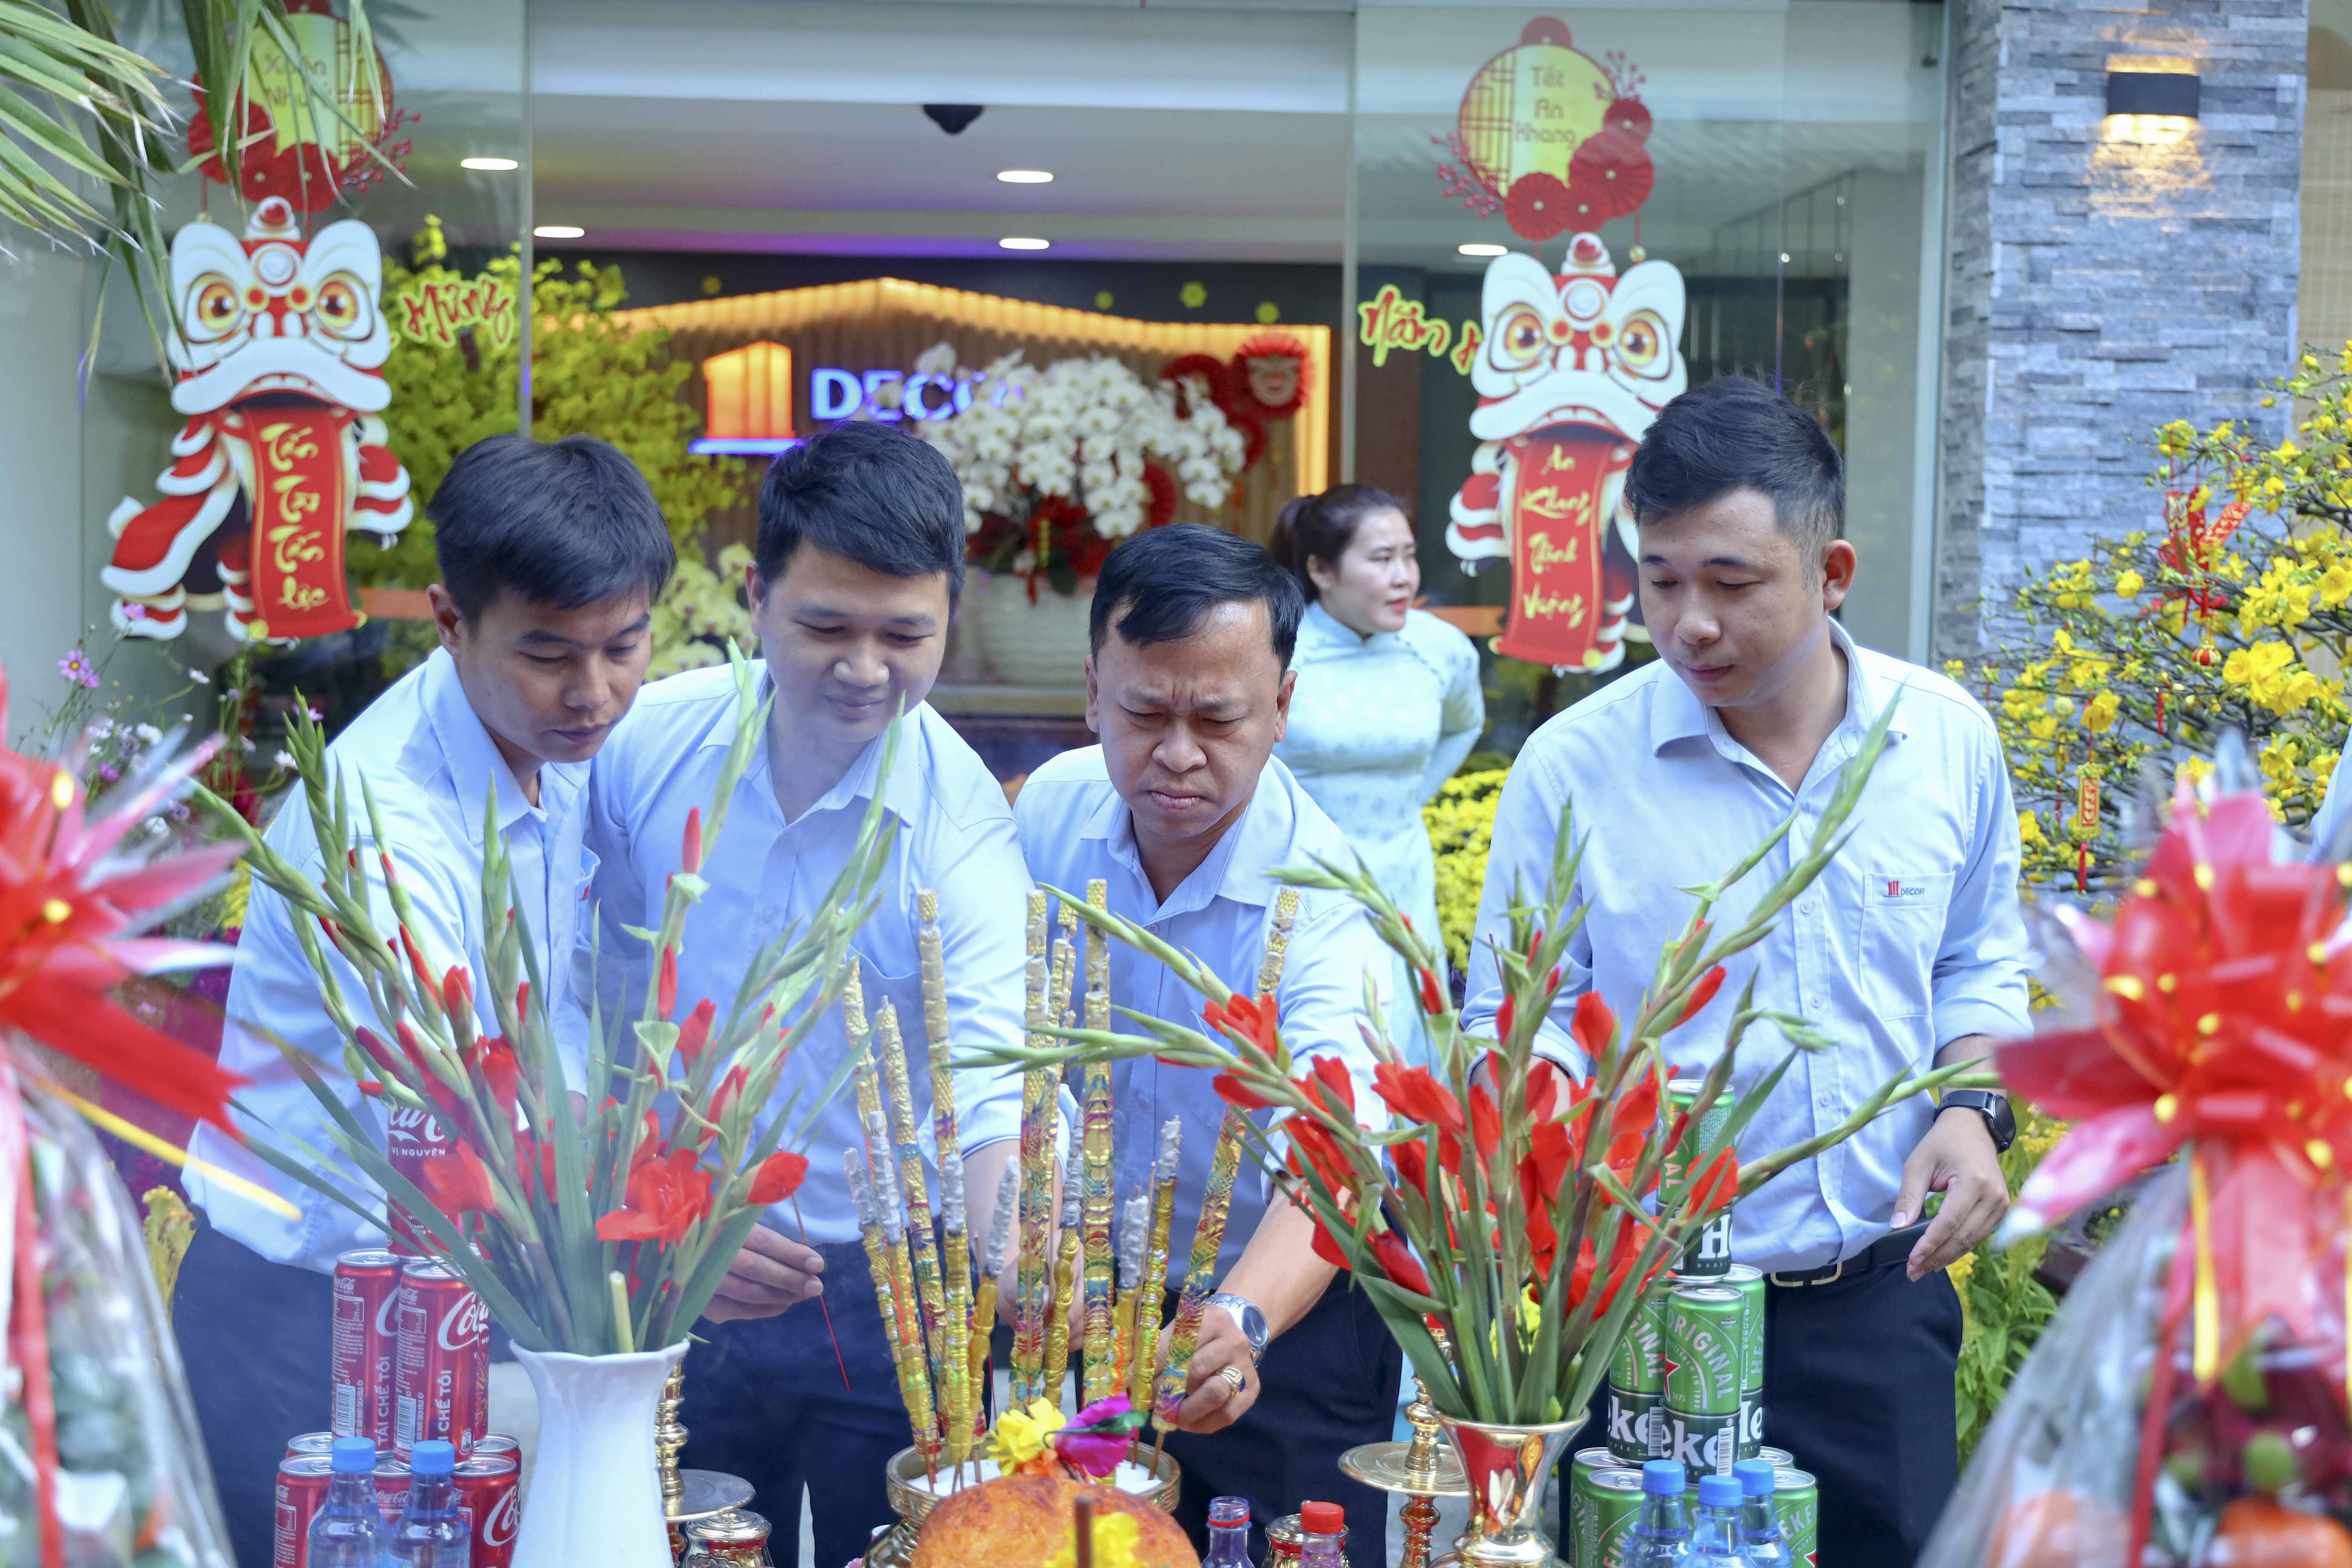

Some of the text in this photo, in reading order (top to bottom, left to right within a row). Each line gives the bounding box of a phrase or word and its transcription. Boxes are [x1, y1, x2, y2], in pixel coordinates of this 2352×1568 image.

[1531, 65, 1565, 87] Tết
[1534, 98, 1564, 119] An
[1514, 122, 1577, 149] Khang
[401, 1147, 446, 1157] NGUYÊN
[1666, 1308, 1735, 1400] ORIGINAL
[437, 1370, 452, 1396] TÔI
[374, 1356, 390, 1446] TÁI CHẾ TÔI
[435, 1399, 451, 1432] CHẾ
